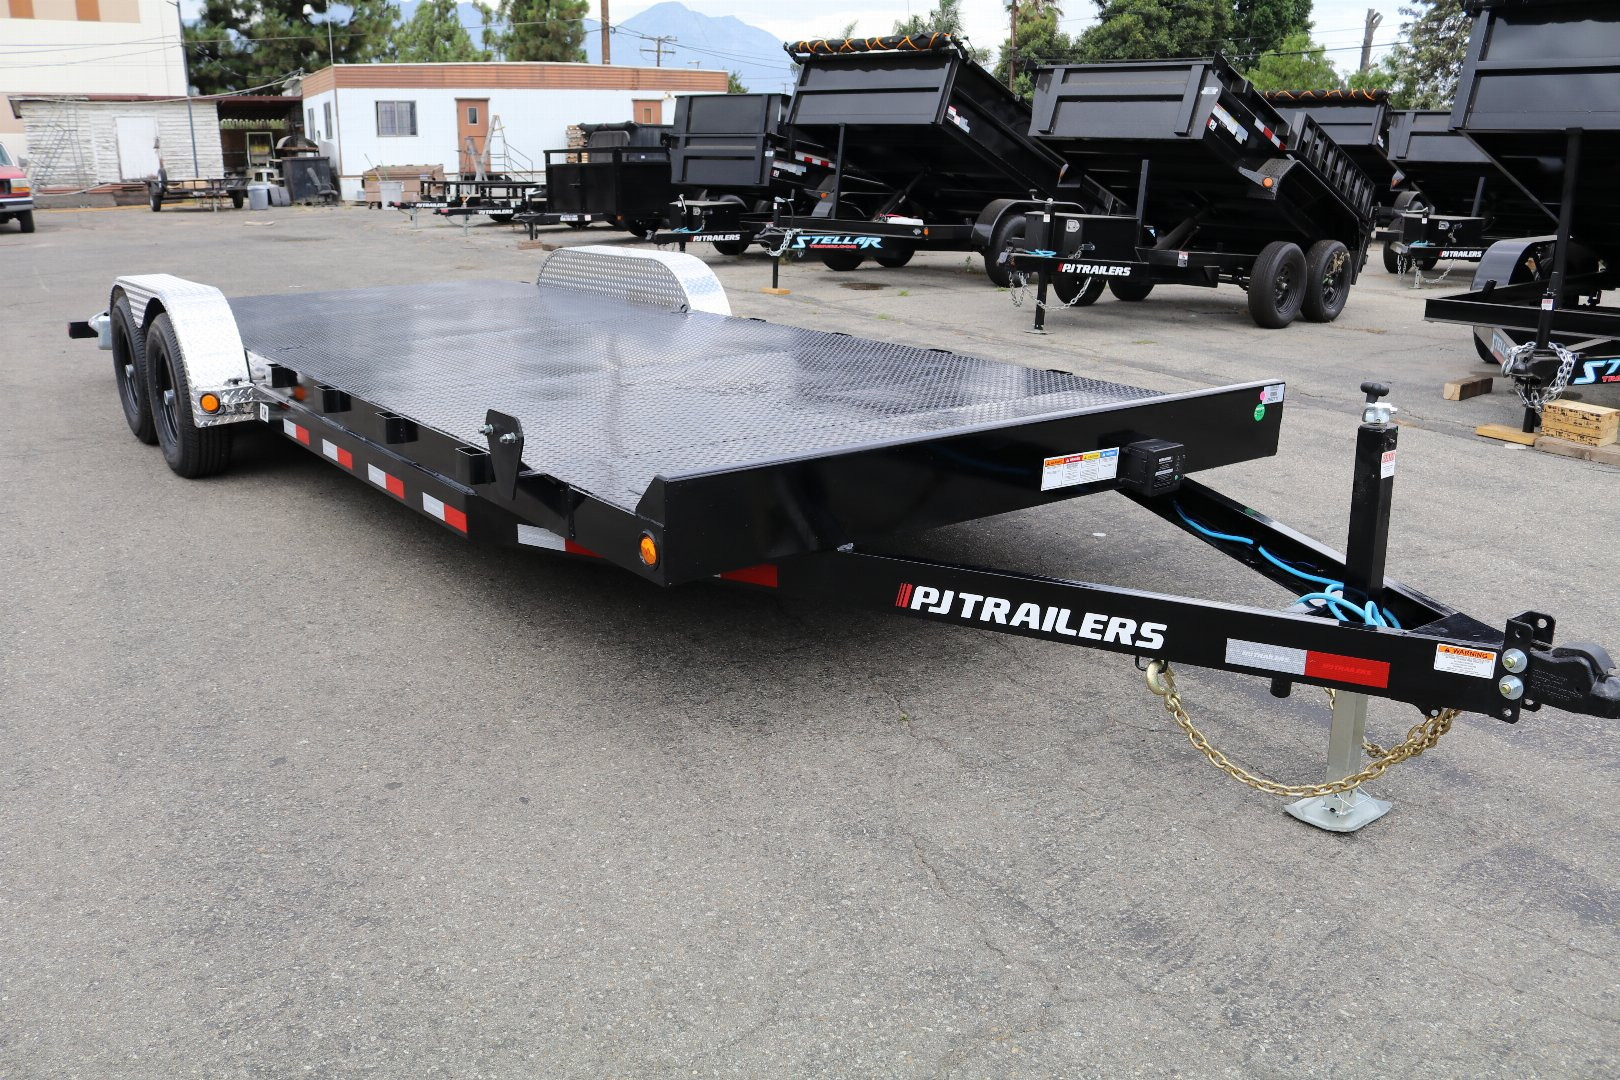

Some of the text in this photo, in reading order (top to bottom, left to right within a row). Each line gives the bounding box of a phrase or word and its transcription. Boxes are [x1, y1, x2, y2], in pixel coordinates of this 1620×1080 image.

[702, 234, 740, 242] TRAILERS
[791, 235, 883, 249] STELLAR
[1442, 250, 1482, 258] PJ TRAILERS
[1062, 263, 1131, 277] PJ TRAILERS
[911, 585, 1168, 650] PJ TRAILERS
[1453, 648, 1488, 659] WARNING
